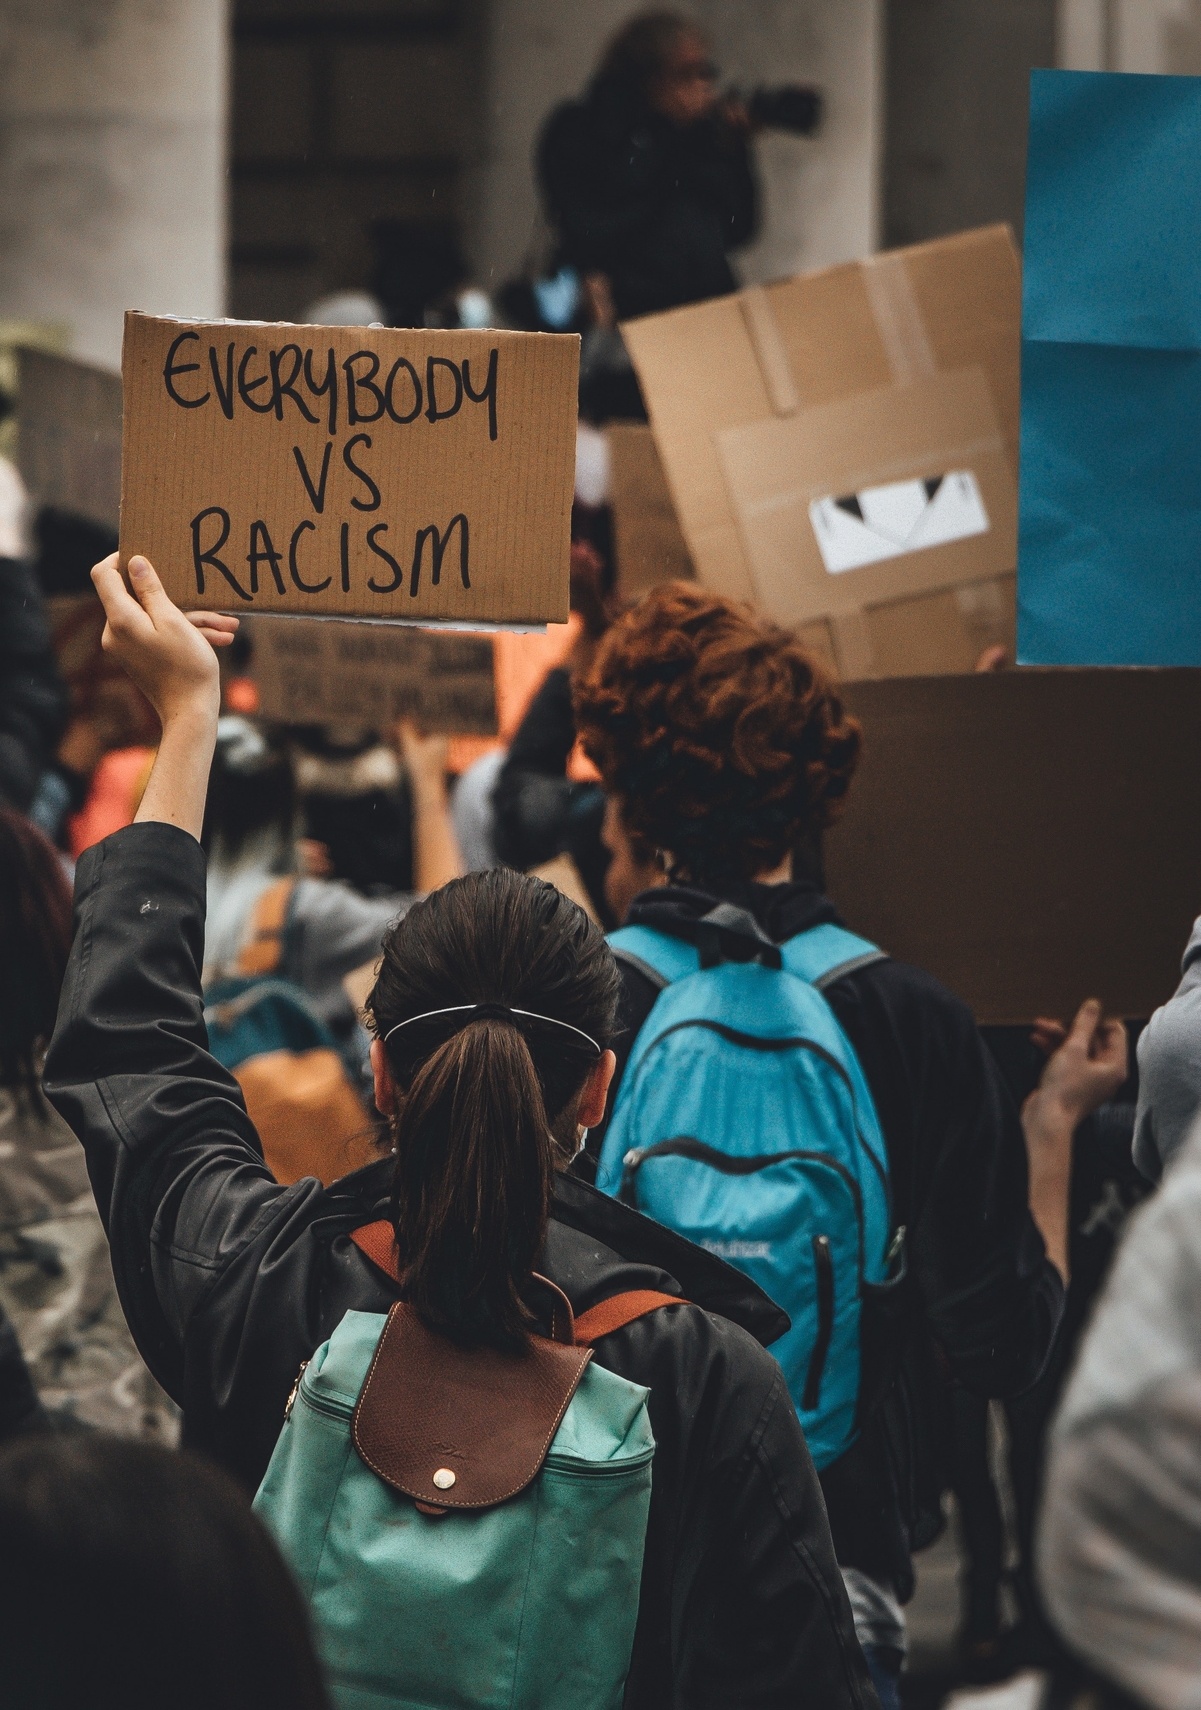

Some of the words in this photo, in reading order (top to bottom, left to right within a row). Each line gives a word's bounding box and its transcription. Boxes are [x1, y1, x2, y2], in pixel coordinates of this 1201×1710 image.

[163, 331, 498, 441] EVERYBODY
[293, 434, 380, 513] VS
[190, 507, 470, 601] RACISM
